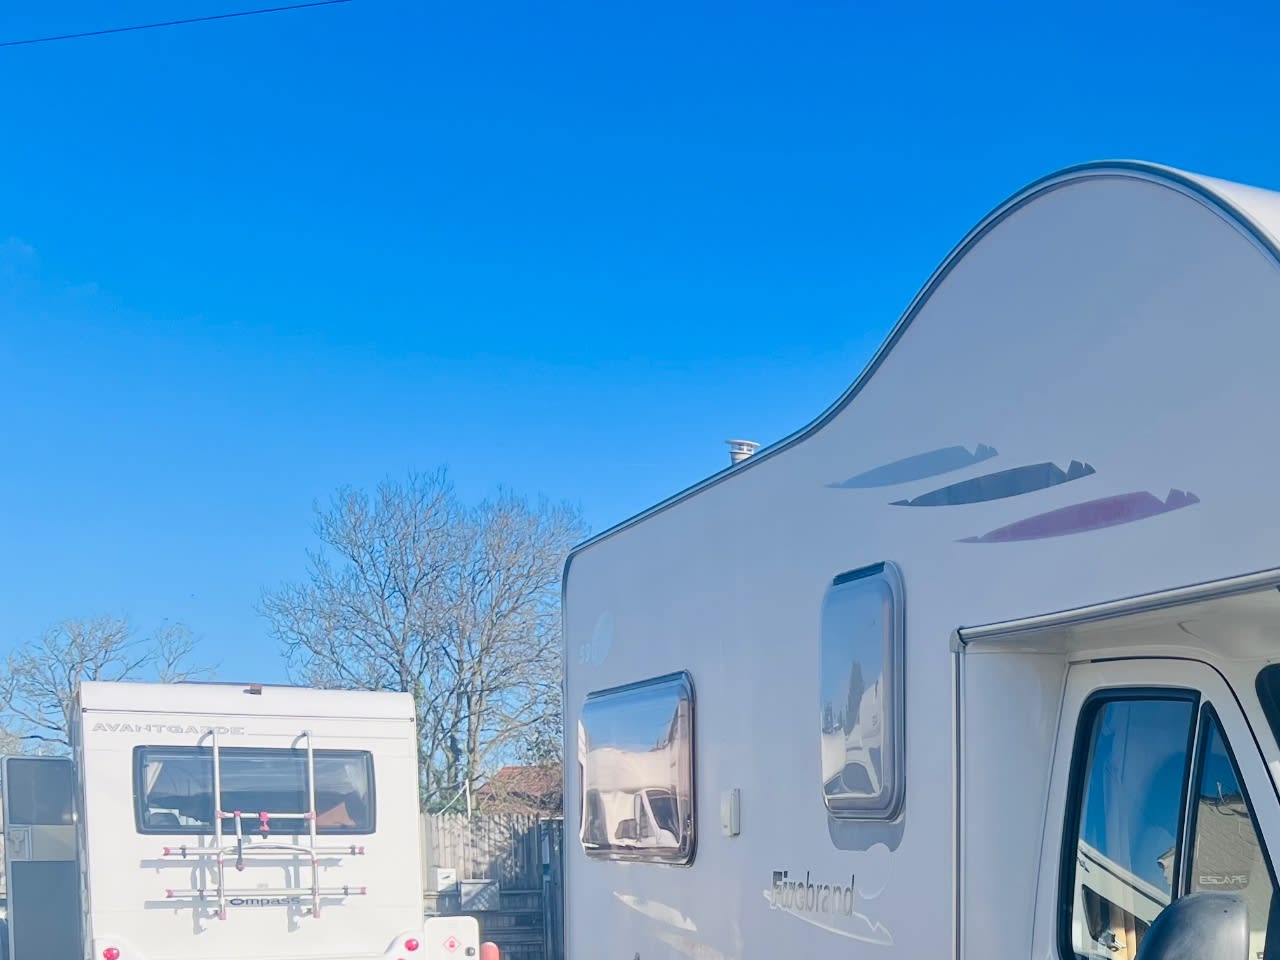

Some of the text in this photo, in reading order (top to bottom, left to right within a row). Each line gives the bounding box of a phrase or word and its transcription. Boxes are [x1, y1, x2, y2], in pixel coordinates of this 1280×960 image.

[1199, 875, 1249, 885] ESCAPE
[772, 870, 855, 916] Firebrand
[224, 896, 301, 907] ompass
